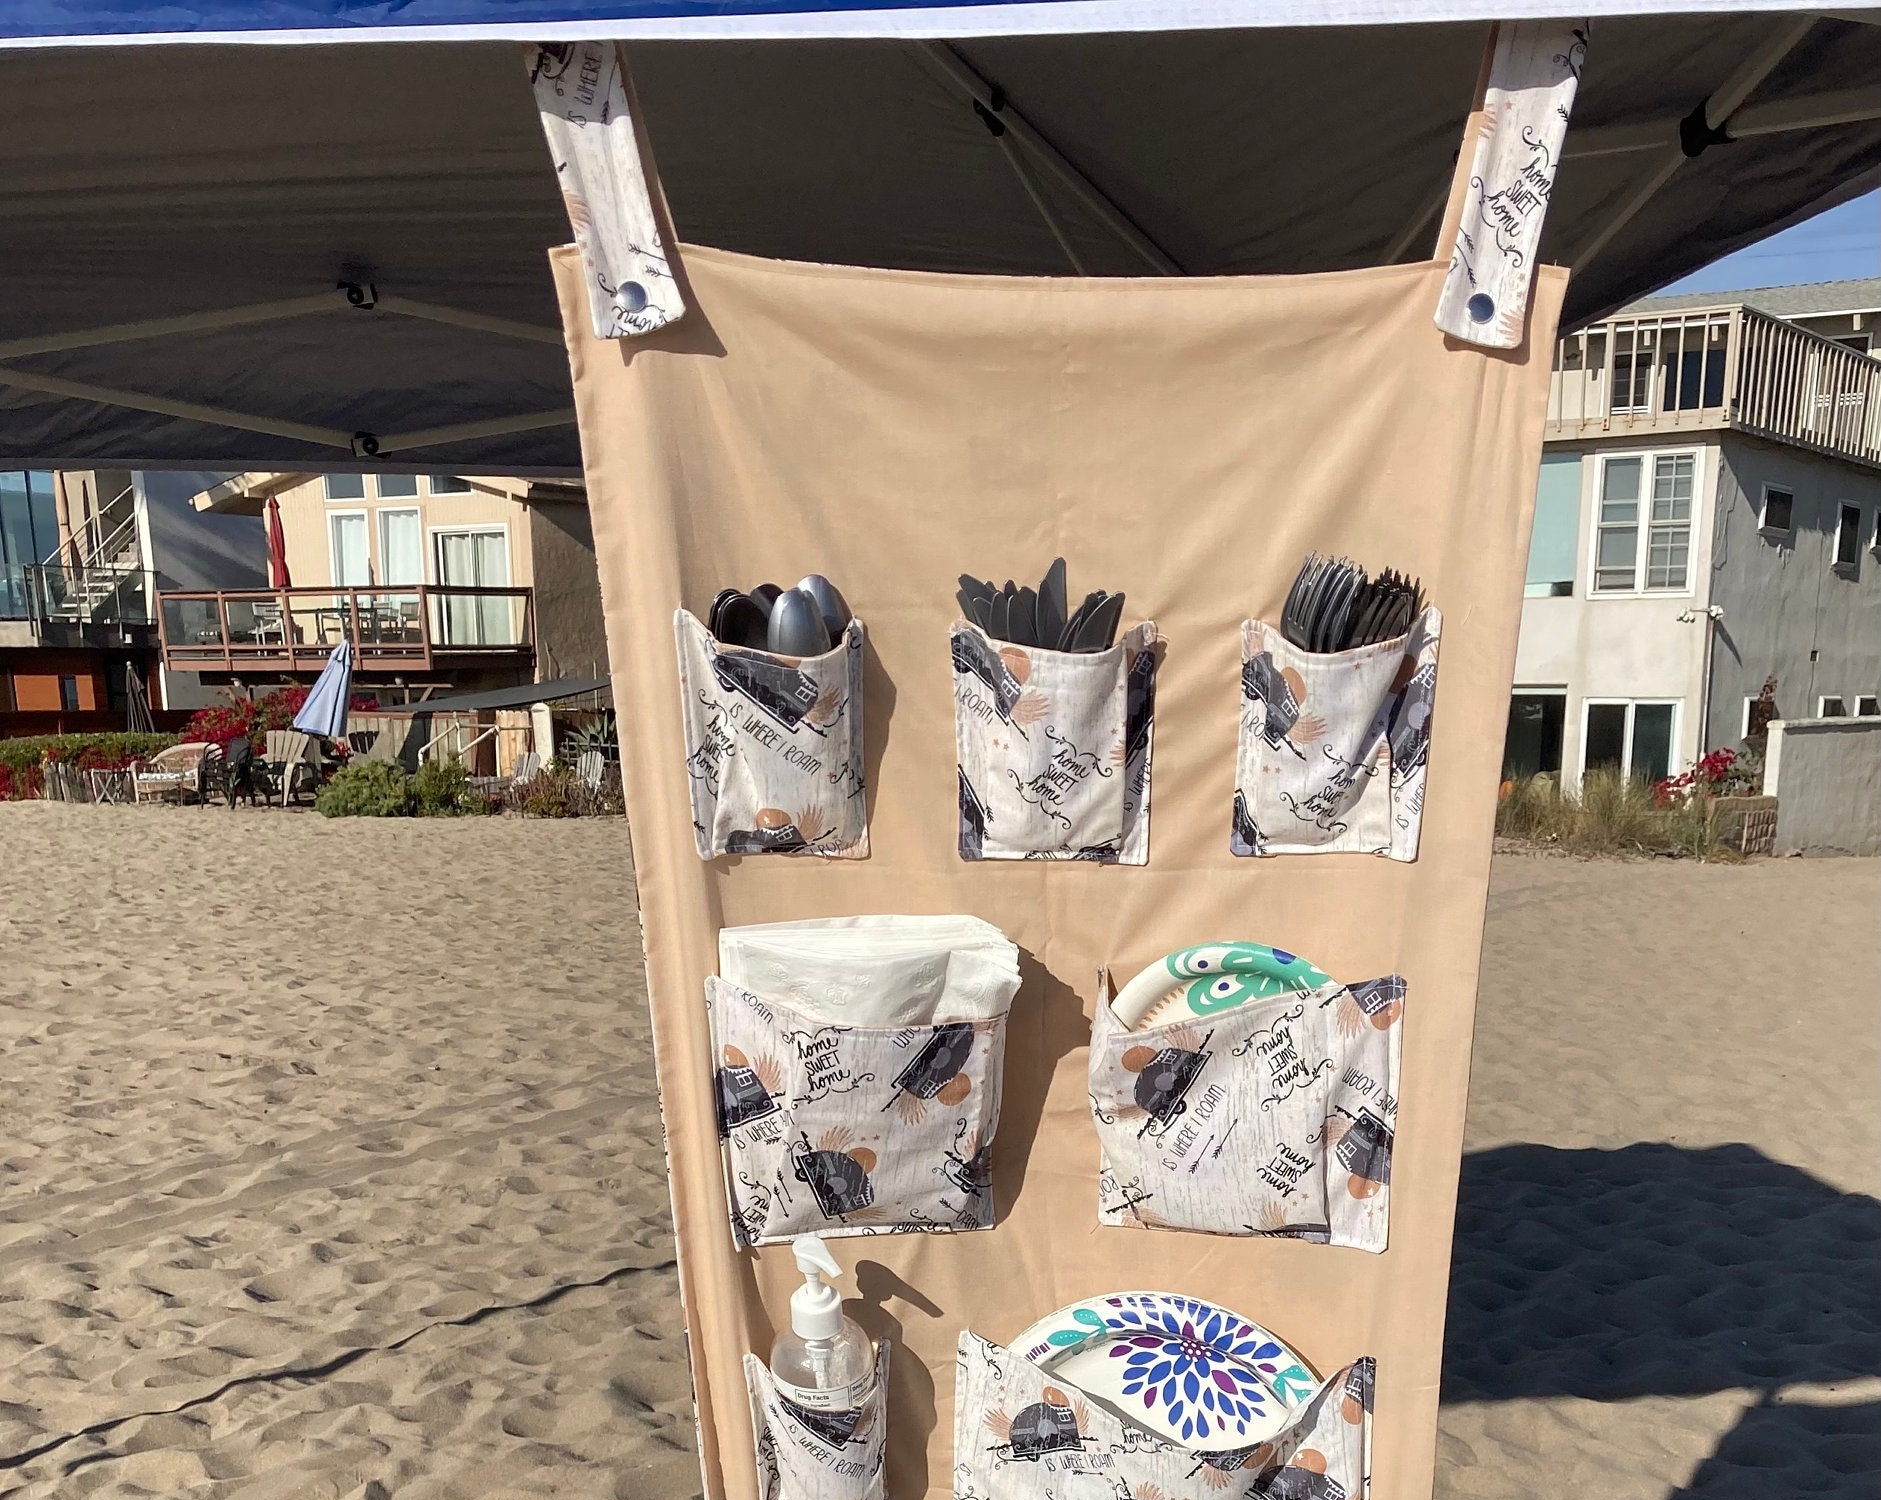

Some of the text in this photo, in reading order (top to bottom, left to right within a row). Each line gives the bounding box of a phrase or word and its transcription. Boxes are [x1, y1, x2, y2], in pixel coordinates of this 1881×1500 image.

[1486, 190, 1521, 238] home
[1505, 179, 1543, 218] SWEET
[729, 702, 743, 719] IS
[742, 713, 782, 750] WHERE
[782, 744, 823, 776] ROAM
[1042, 763, 1079, 793] SWEET
[1051, 748, 1091, 779] home
[1025, 774, 1065, 806] home
[797, 1037, 839, 1060] home
[1256, 1025, 1295, 1057] home
[804, 1049, 841, 1077] SWEET
[1267, 1043, 1299, 1078] SWEET
[1272, 1057, 1310, 1089] home
[807, 1069, 851, 1093] home
[1341, 1066, 1377, 1096] ROAM
[1194, 1083, 1227, 1121] ROAM
[745, 1116, 783, 1143] WHERE
[1169, 1122, 1201, 1159] WHERE
[1161, 1157, 1178, 1172] IS
[1265, 1156, 1303, 1184] SWEET
[1275, 1142, 1317, 1175] home
[1256, 1167, 1298, 1198] home
[797, 1393, 812, 1401] Drug
[799, 1437, 832, 1464] WHERE
[833, 1458, 866, 1480] ROAM
[1044, 1458, 1056, 1472] IS
[1059, 1455, 1085, 1470] WHERE
[1089, 1452, 1116, 1469] ROAM
